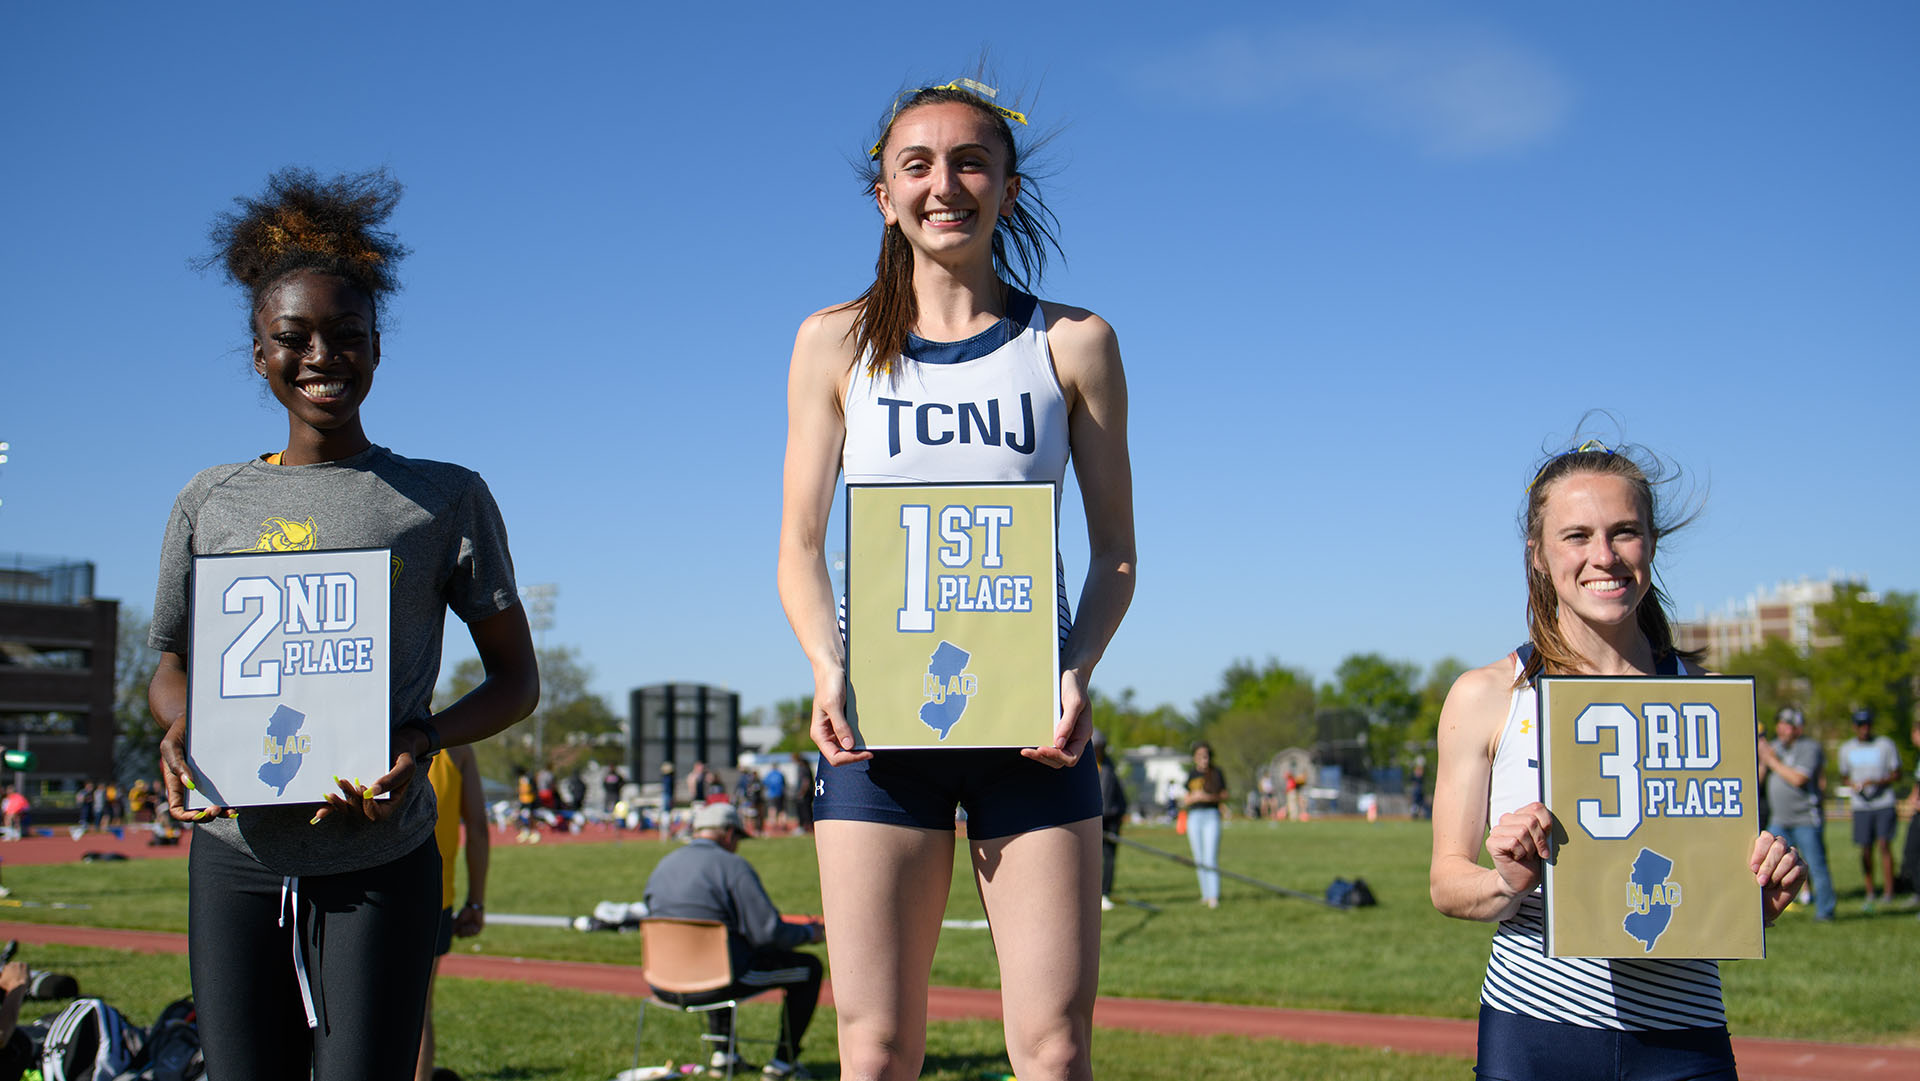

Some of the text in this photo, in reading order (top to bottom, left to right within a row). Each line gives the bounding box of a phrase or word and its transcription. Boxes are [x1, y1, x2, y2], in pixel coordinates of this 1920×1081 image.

[877, 392, 1036, 458] TCNJ
[897, 504, 1013, 633] 1ST
[937, 575, 1033, 612] PLACE
[220, 572, 357, 698] 2ND
[283, 637, 373, 675] PLACE
[1575, 702, 1721, 841] 3RD
[1644, 778, 1743, 818] PLACE
